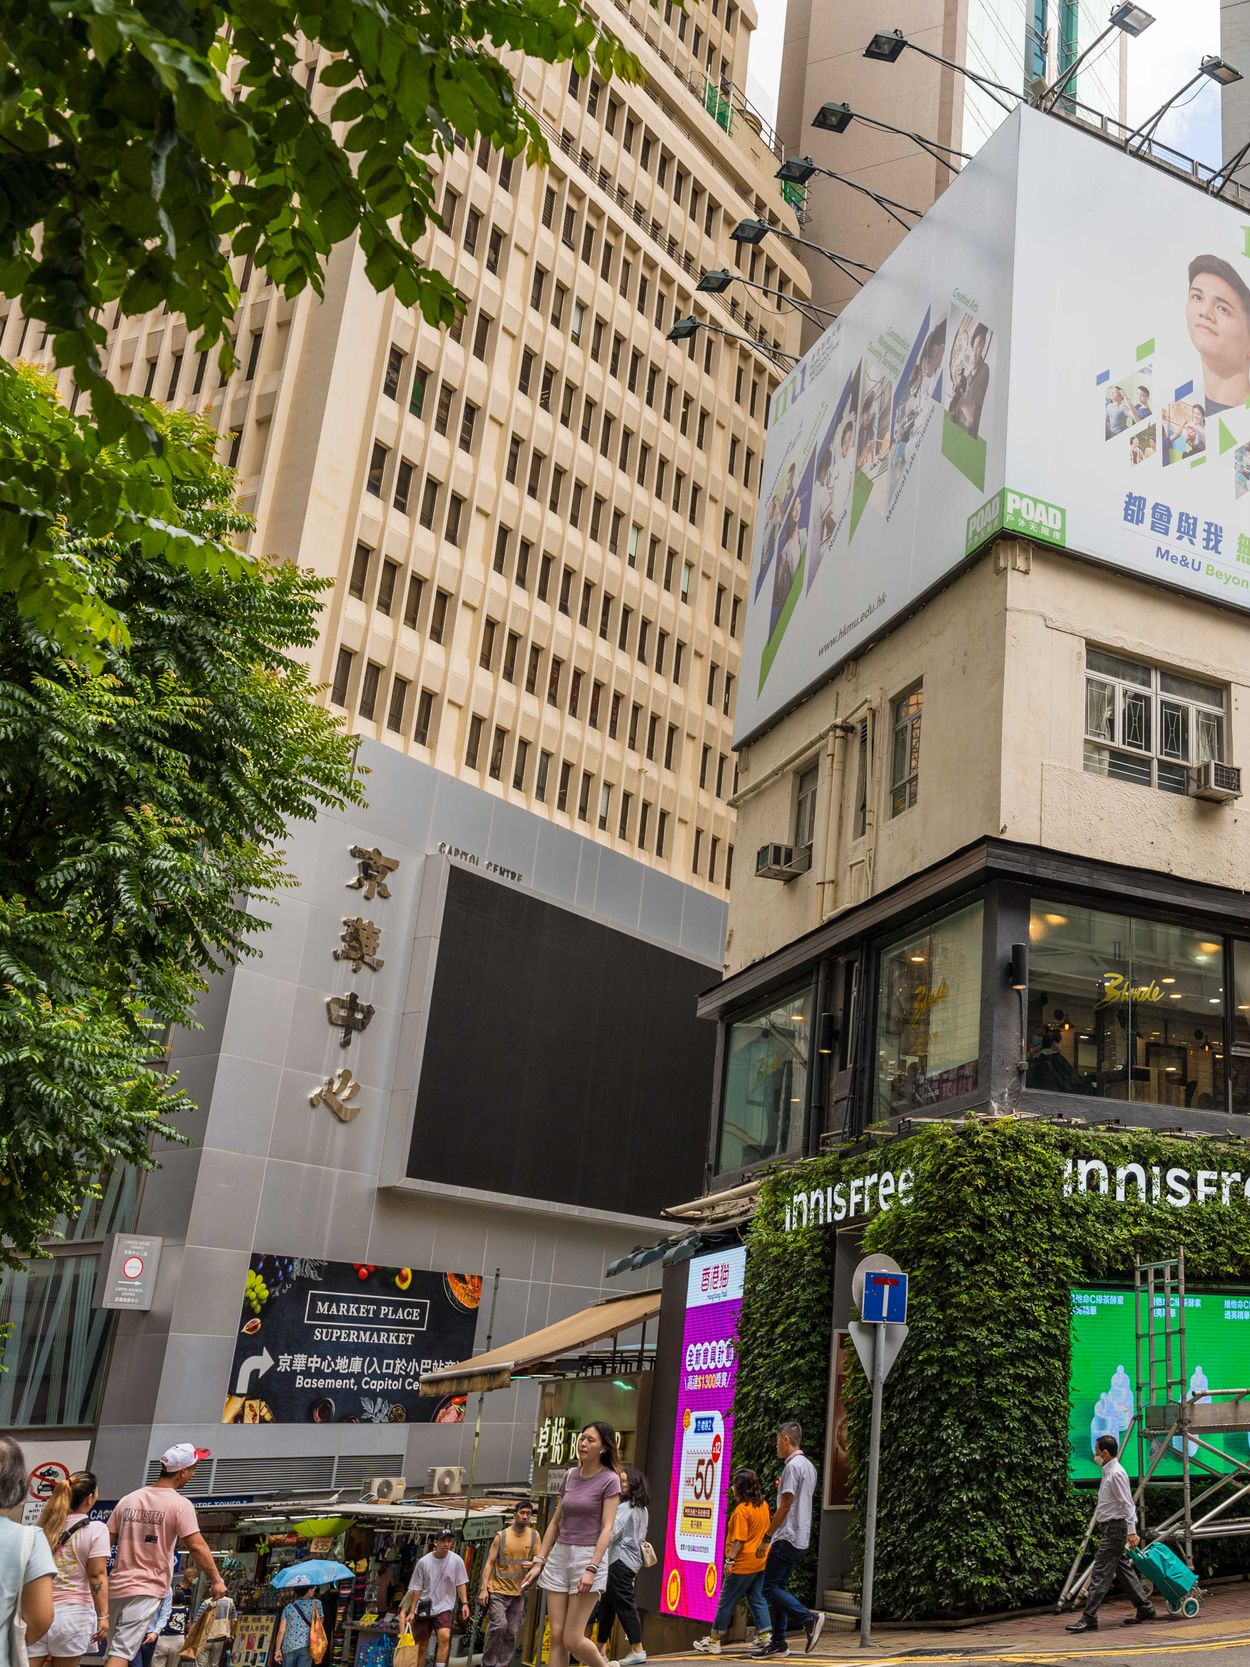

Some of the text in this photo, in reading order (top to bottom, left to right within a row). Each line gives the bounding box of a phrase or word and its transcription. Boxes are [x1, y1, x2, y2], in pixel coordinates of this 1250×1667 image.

[885, 405, 935, 522] Medical Lab Science
[828, 509, 847, 551] Nursing
[968, 496, 1000, 539] POAD
[1007, 492, 1062, 530] POAD
[1123, 491, 1224, 555] 都會與我
[1156, 546, 1202, 572] Me&U
[818, 591, 886, 657] www.hkmu.edu.hk
[310, 845, 400, 1123] 京華中心
[1094, 972, 1165, 1011] Blonde
[316, 1301, 420, 1321] MARKET PLACE
[314, 1328, 415, 1345] SUPERMARKET
[295, 1376, 358, 1391] Basement,
[361, 1378, 402, 1391] Capitol
[694, 1458, 714, 1500] 50
